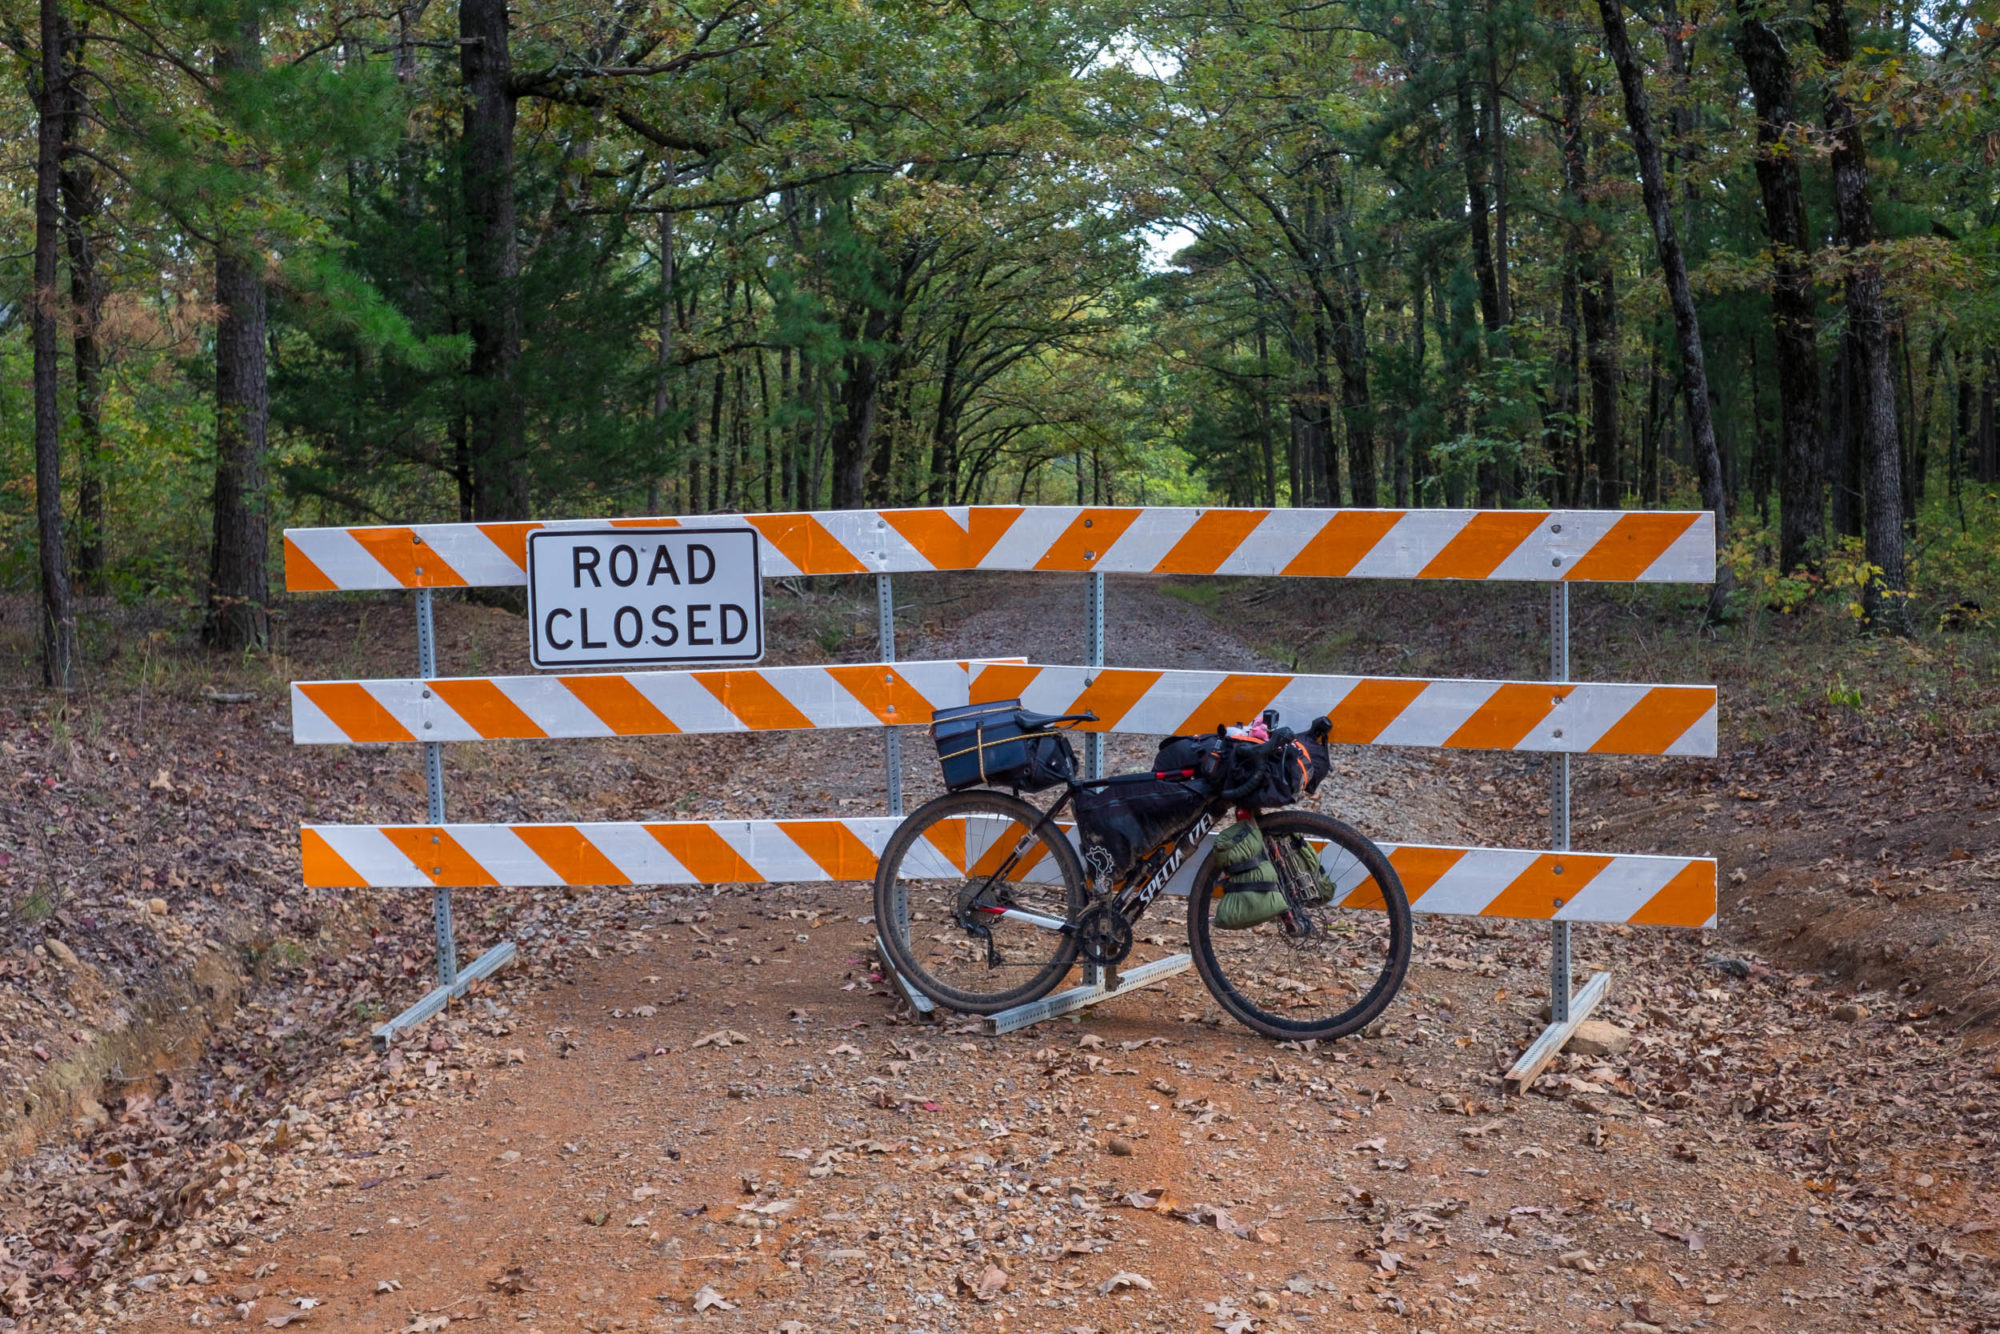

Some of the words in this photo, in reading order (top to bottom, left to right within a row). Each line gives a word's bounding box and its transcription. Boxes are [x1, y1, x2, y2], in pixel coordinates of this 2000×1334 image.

[572, 543, 716, 588] ROAD
[545, 603, 748, 650] CLOSED
[1139, 812, 1214, 910] SPECIAIZE
